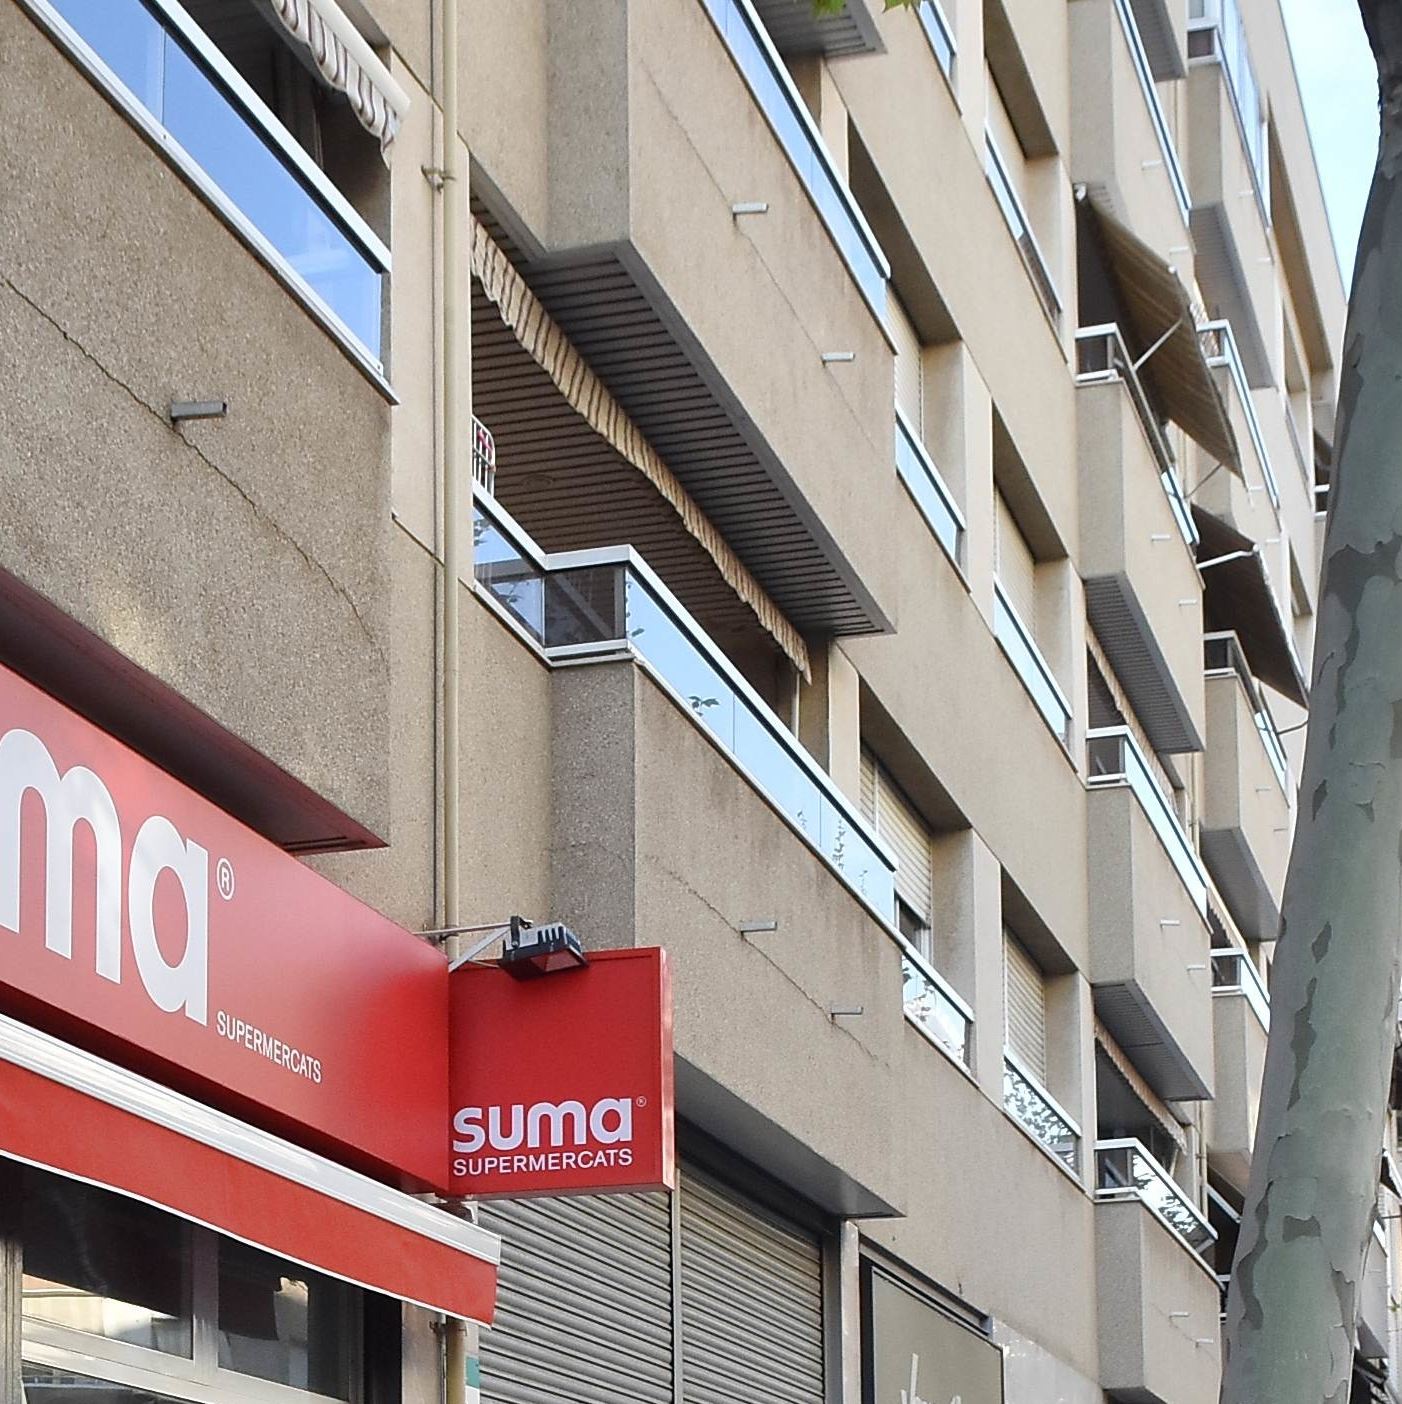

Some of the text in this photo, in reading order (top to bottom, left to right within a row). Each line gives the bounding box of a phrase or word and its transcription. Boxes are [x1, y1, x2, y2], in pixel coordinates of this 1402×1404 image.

[216, 1010, 322, 1084] SUPERMERCATS
[453, 1098, 632, 1153] suma
[453, 1149, 633, 1177] SUPERMERCATS
